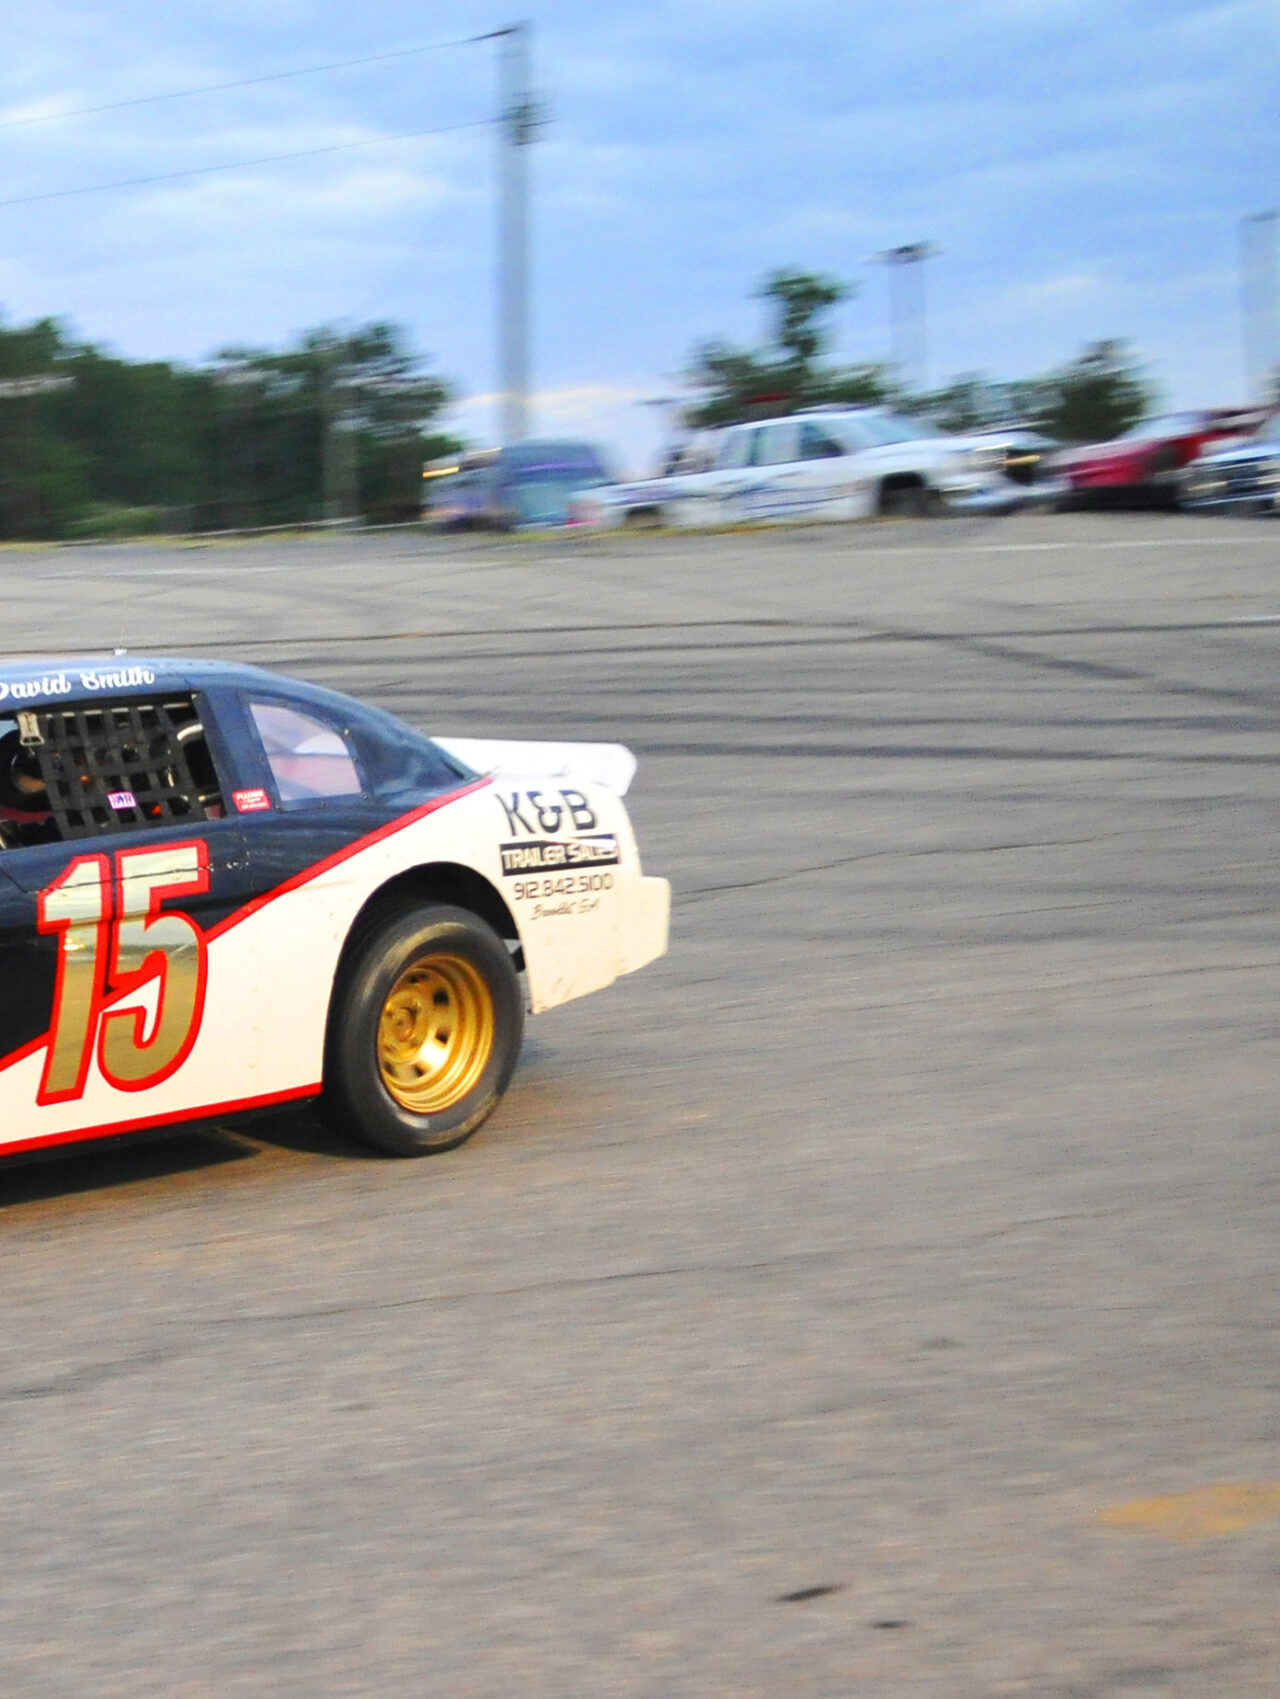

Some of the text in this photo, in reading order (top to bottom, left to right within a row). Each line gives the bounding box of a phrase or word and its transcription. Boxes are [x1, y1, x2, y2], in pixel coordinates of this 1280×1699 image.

[79, 665, 155, 691] Smith
[494, 789, 596, 836] K&B
[501, 845, 566, 870] TRAILER
[36, 839, 210, 1107] 15
